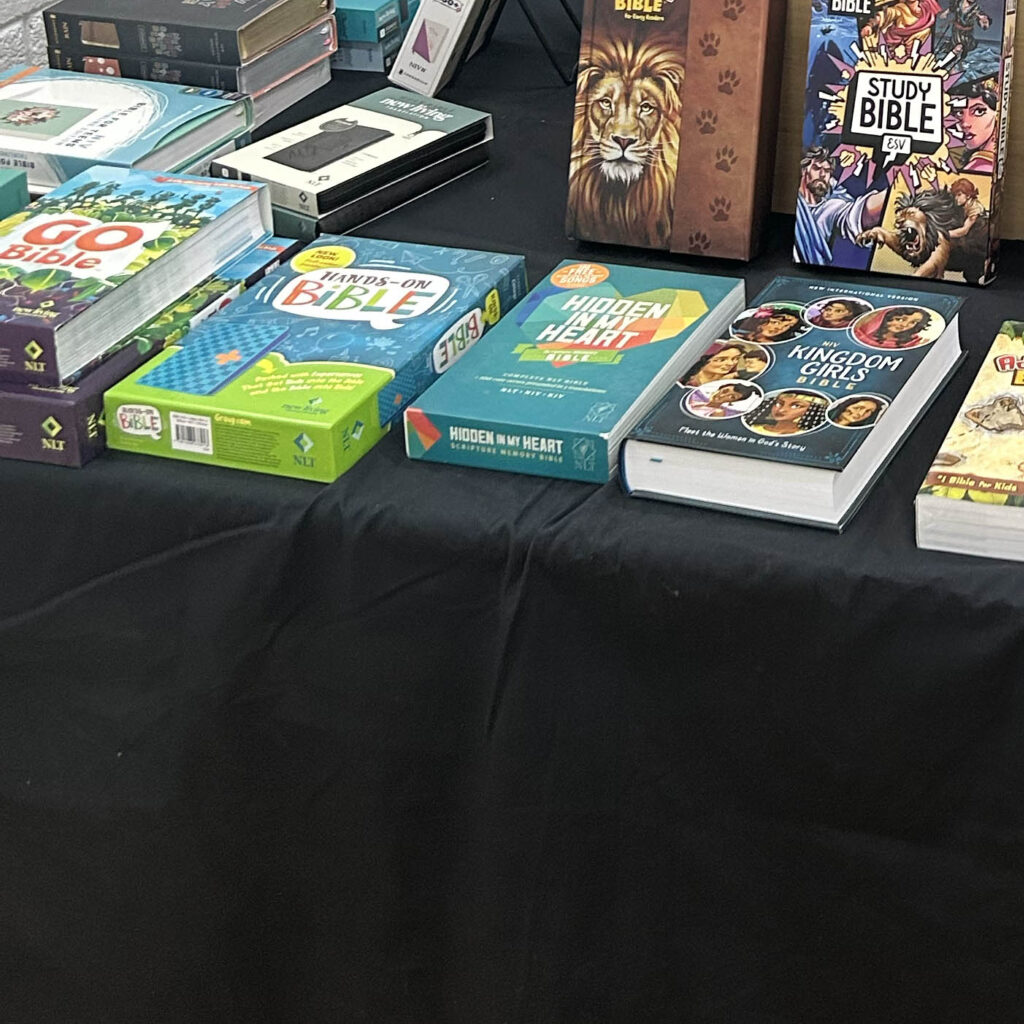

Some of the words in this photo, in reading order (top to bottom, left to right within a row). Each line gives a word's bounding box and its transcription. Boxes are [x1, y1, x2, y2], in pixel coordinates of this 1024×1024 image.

[867, 76, 932, 102] STUDY
[412, 102, 454, 123] living
[859, 102, 936, 135] BIBLE
[886, 137, 908, 152] ESV
[23, 219, 144, 252] GO
[1, 243, 102, 270] Bible
[319, 270, 432, 290] HANDS-ON
[568, 268, 594, 277] FREE
[809, 284, 824, 292] NEW
[827, 287, 885, 299] INTERNATIONAL
[887, 294, 920, 303] VERSION
[562, 294, 672, 319] HIDDEN
[564, 310, 590, 326] IN
[590, 311, 637, 332] MY
[536, 324, 639, 350] HEART
[822, 341, 840, 349] NIV
[25, 361, 46, 372] NLT
[545, 353, 592, 362] BIBLE
[787, 345, 904, 372] KINGDOM
[502, 372, 544, 382] COMPLETE
[799, 361, 871, 383] GIRLS
[524, 389, 543, 397] NIV
[796, 376, 857, 391] BIBLE
[42, 439, 66, 451] NLT
[450, 426, 494, 445] HIDDEN
[496, 434, 505, 446] IN
[506, 435, 521, 447] MY
[523, 434, 564, 455] HEART
[679, 426, 701, 436] Meet
[702, 428, 716, 438] the
[757, 437, 781, 448] God's
[782, 441, 807, 452] Story
[293, 454, 315, 468] NLT
[451, 442, 497, 455] SCRIPTURE
[500, 447, 537, 460] MEMORY
[539, 452, 564, 464] BIBLE
[949, 475, 976, 487] Bible
[978, 479, 992, 488] for
[994, 482, 1018, 492] Kids
